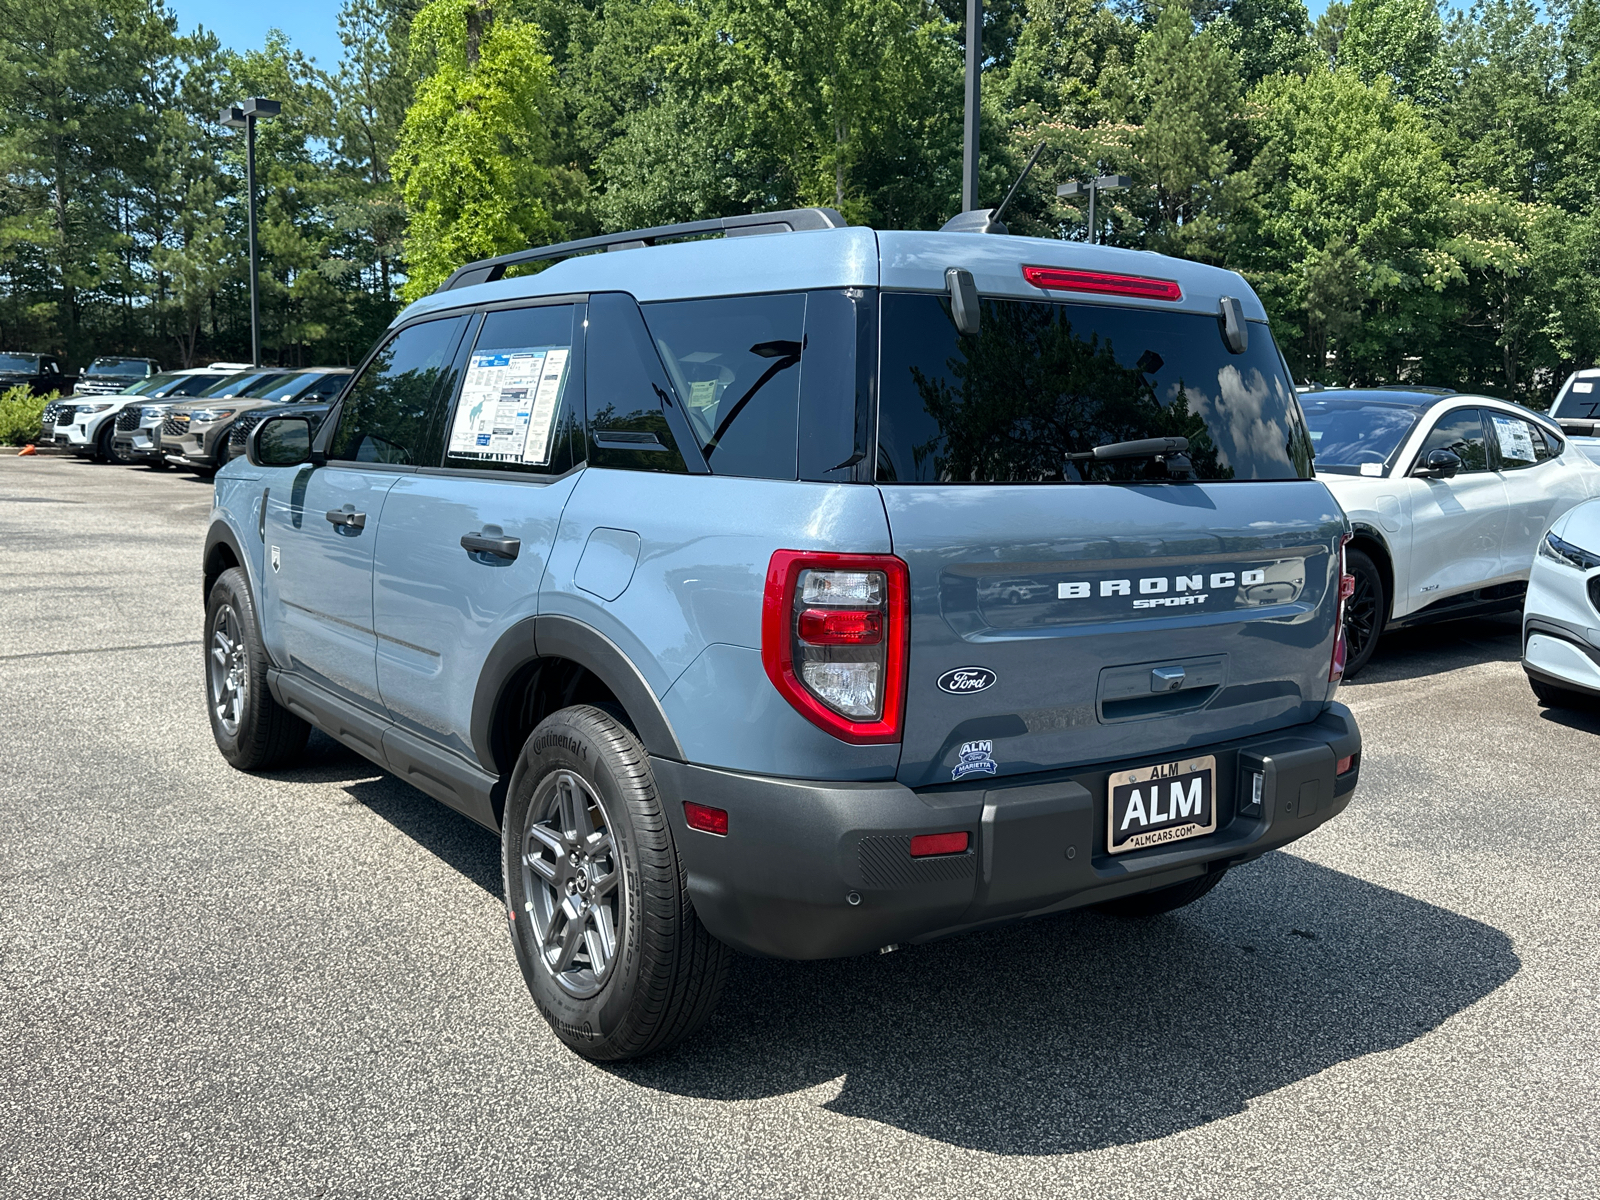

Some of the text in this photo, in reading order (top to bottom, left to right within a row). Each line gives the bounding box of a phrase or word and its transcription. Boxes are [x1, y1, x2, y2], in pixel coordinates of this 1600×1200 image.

[1057, 569, 1266, 600] BRONCO
[1132, 593, 1209, 609] SPORT
[949, 670, 988, 691] Ford
[533, 730, 582, 757] Continental
[960, 741, 991, 755] ALM
[958, 762, 991, 772] MARIETTA
[1150, 762, 1179, 780] ALM
[1120, 776, 1203, 831] ALM
